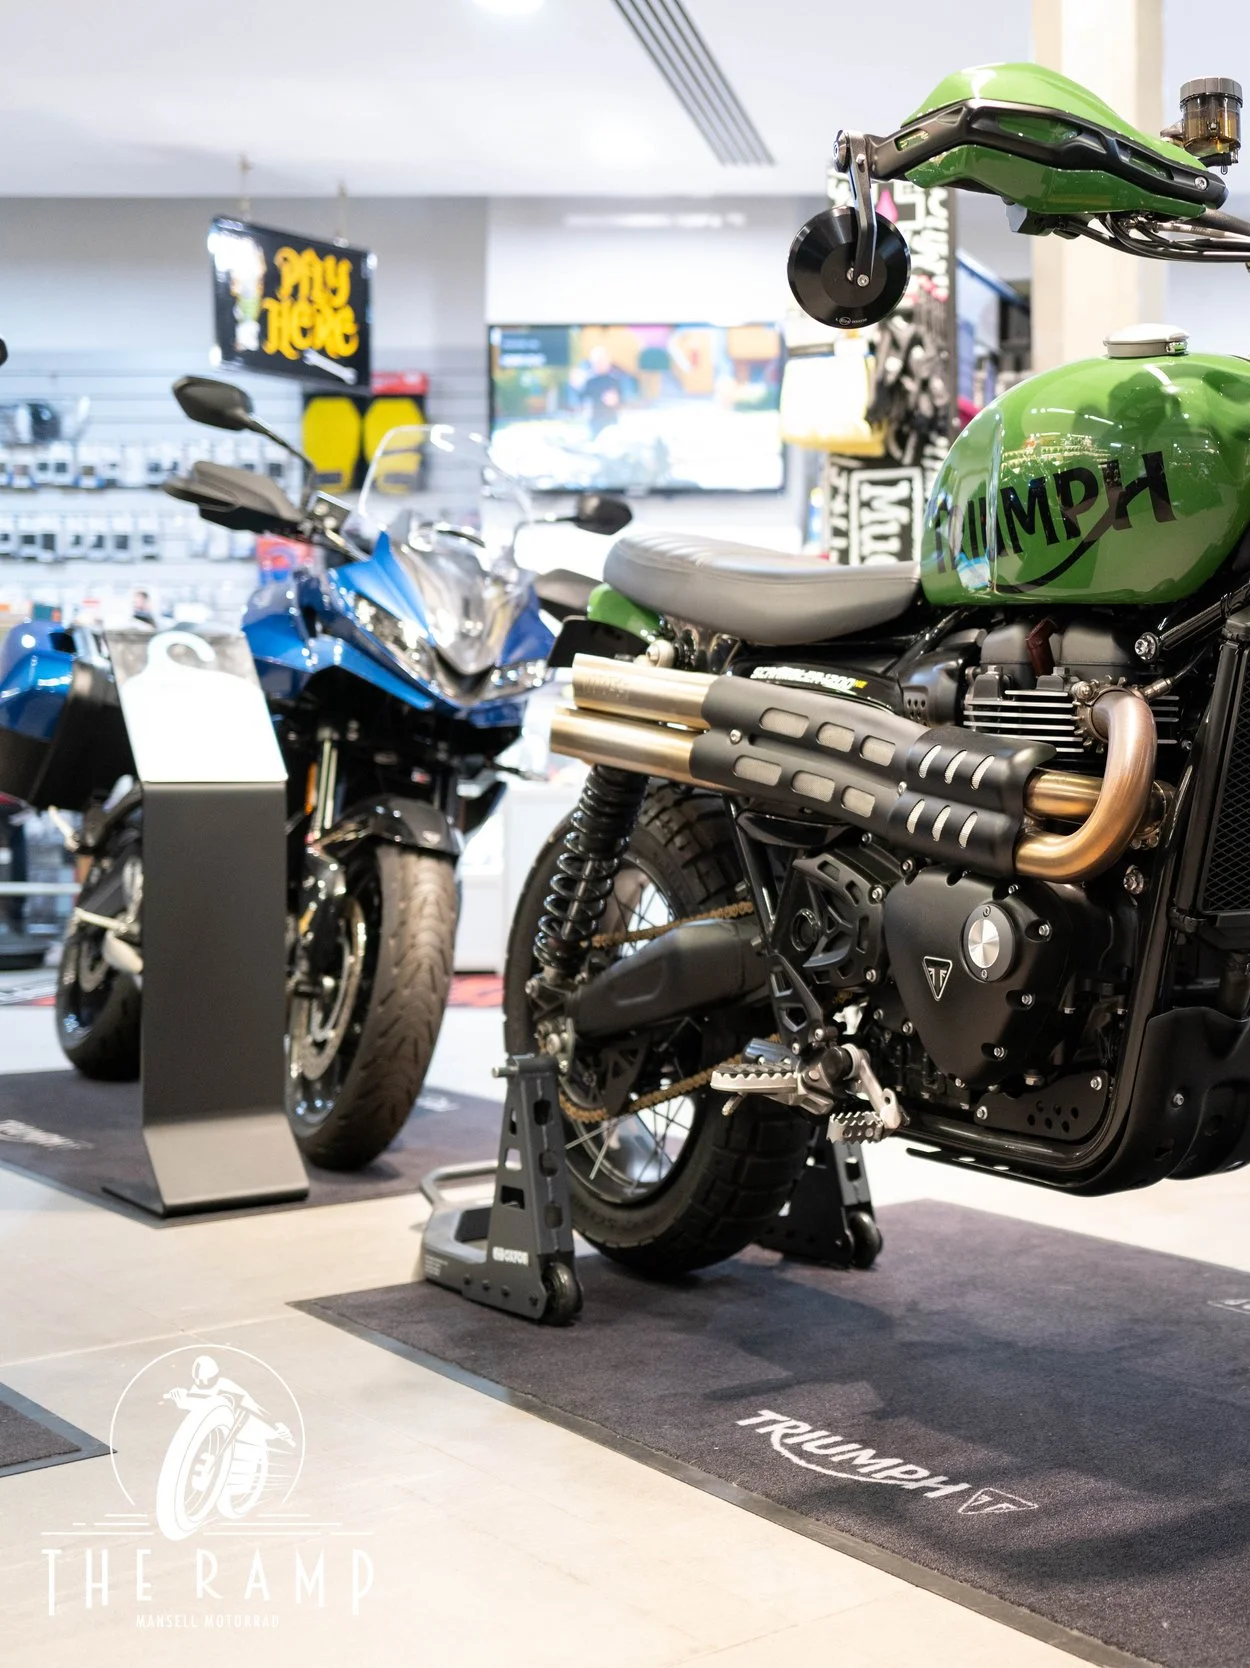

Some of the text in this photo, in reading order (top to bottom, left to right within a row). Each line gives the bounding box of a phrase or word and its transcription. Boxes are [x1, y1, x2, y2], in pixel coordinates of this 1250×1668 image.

[274, 246, 353, 309] PAY
[261, 297, 359, 360] HERE
[736, 1410, 971, 1498] TRIUMPH
